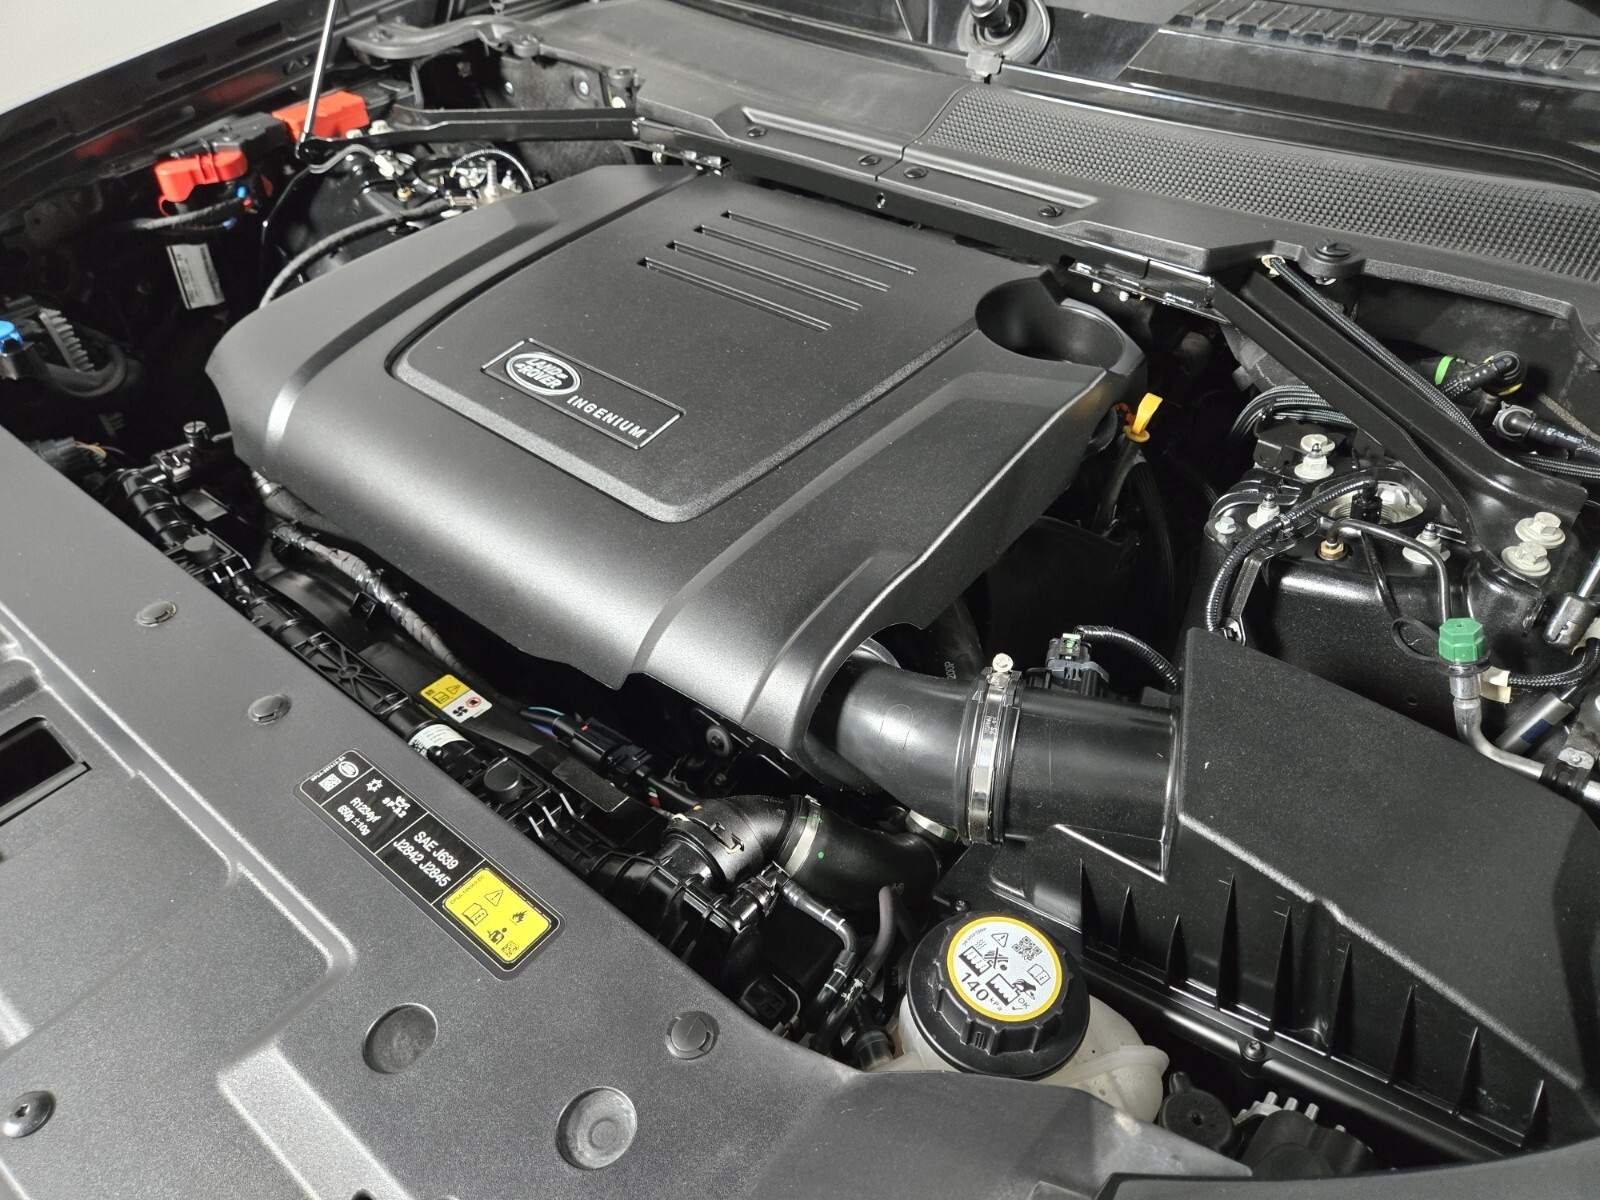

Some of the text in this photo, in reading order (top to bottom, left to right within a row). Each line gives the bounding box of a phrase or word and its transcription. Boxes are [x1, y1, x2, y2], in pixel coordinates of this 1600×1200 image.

[520, 366, 563, 388] ROVER
[525, 357, 562, 377] LAND
[567, 395, 648, 439] INGENIUM
[350, 797, 381, 823] R1234yf
[393, 839, 451, 887] J2842 J2845
[414, 831, 459, 870] SAE J639
[961, 972, 989, 1001] 140
[1018, 997, 1031, 1009] OK
